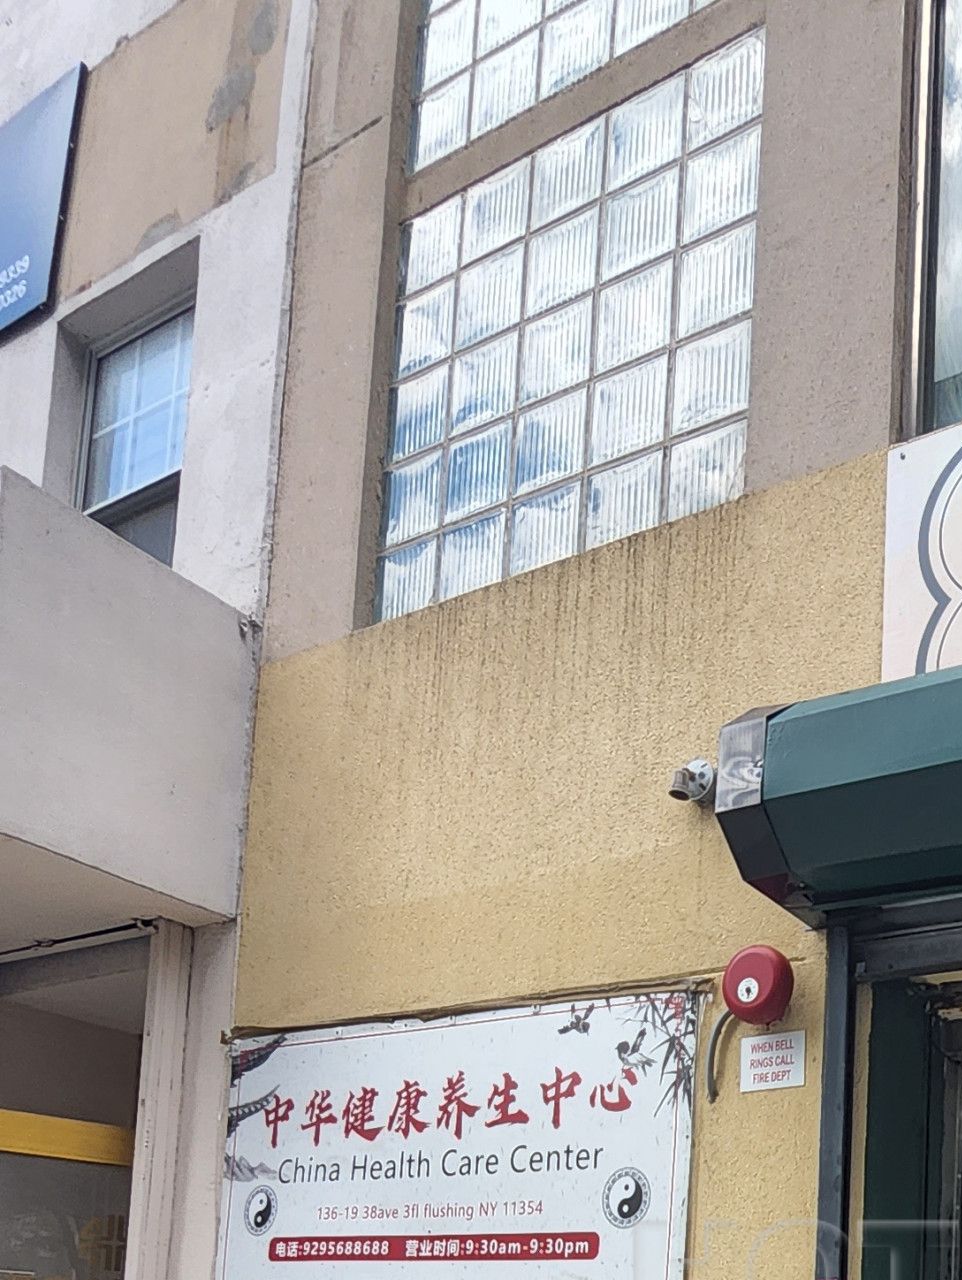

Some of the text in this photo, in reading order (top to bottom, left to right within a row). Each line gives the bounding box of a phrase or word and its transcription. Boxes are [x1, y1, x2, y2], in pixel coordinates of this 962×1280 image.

[751, 1038, 795, 1054] WHEN BELL
[750, 1054, 795, 1069] RINGS CALL
[752, 1069, 791, 1084] FIRE DEPT
[264, 1065, 640, 1149] 中华健康养生中心
[278, 1144, 603, 1184] China Health Care Center
[317, 1200, 543, 1221] 136-19 38ave 3fl flushing NY 11354
[276, 1238, 588, 1257] 电话:9295688688 营业时间:9:30am-9:30pm
